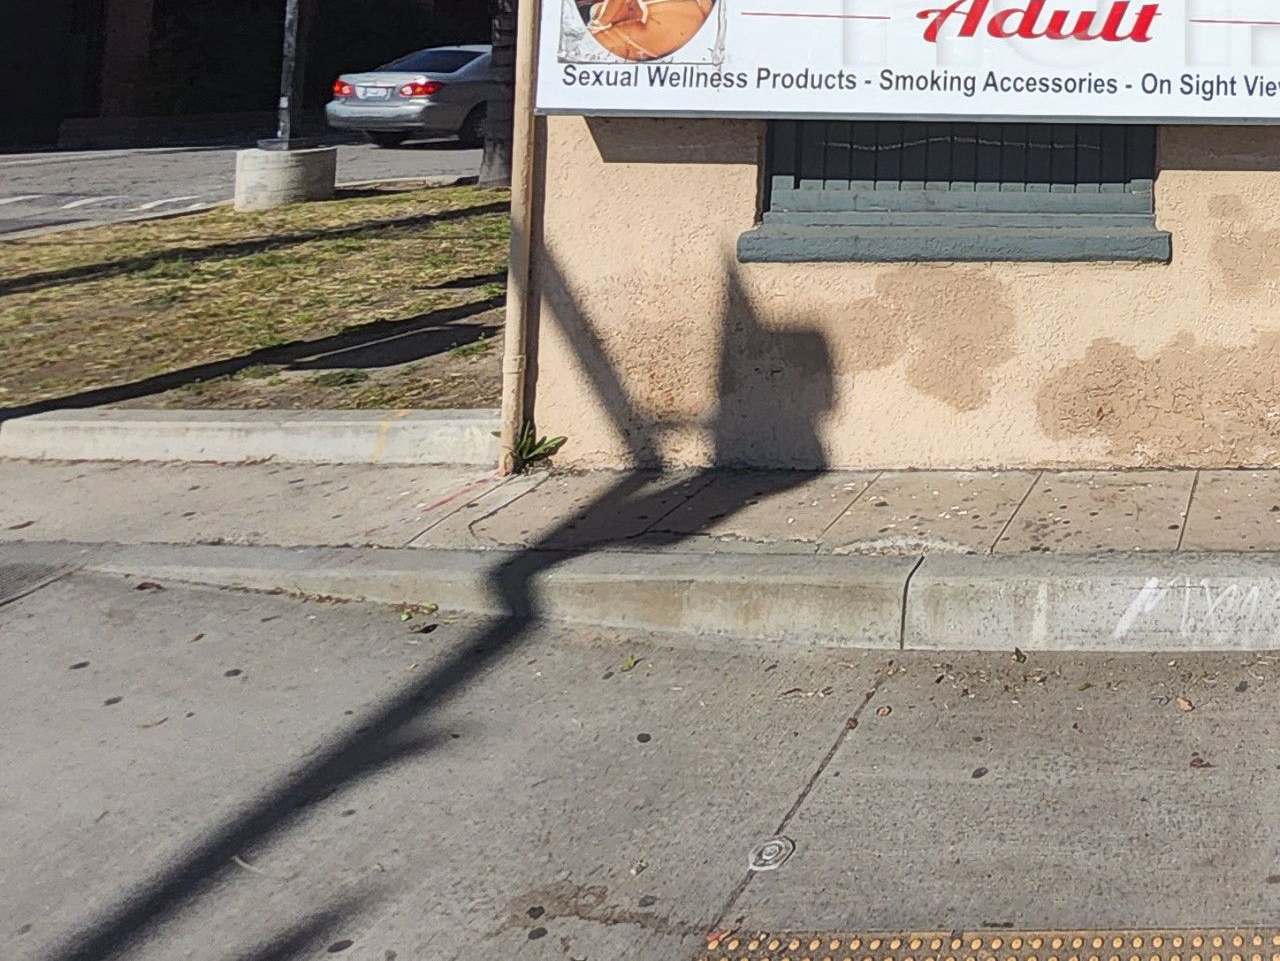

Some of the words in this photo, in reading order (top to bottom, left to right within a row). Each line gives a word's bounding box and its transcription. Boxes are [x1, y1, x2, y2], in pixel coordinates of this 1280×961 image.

[561, 64, 639, 88] Sexual
[646, 65, 748, 89] Wellness
[756, 67, 857, 90] Products
[879, 69, 977, 98] Smoking
[982, 71, 1118, 94] Accessories
[1141, 72, 1172, 95] On
[1179, 73, 1237, 101] Sight
